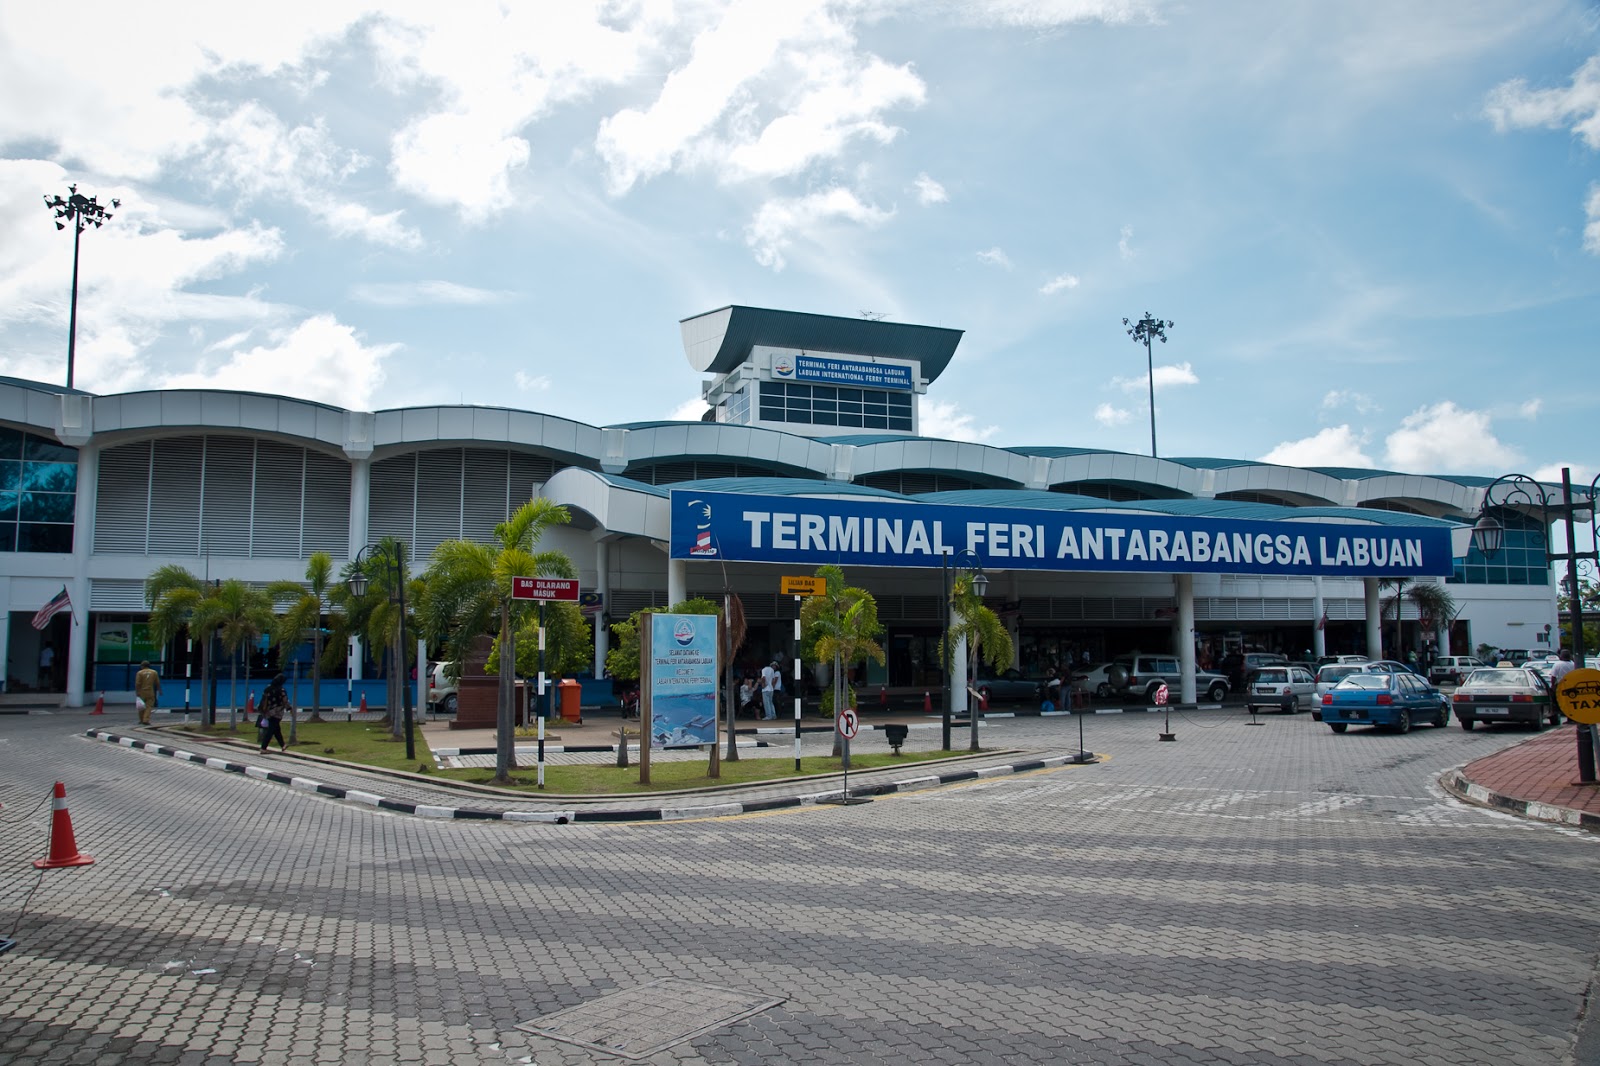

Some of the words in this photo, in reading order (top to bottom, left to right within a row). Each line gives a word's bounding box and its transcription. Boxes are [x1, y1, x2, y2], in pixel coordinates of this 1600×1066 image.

[798, 360, 826, 368] TERMINAL
[842, 364, 883, 374] ANTARABANGSA
[798, 369, 820, 377] LABUAN
[822, 372, 864, 382] INTERNATIONAL
[865, 375, 883, 383] FERRY
[884, 377, 910, 385] TERMINAL
[743, 511, 954, 556] TERMINAL
[966, 521, 1045, 559] FERI
[1056, 525, 1312, 566] ANTARABANGSA
[1319, 536, 1423, 567] LABUAN
[536, 582, 570, 590] DILARANG
